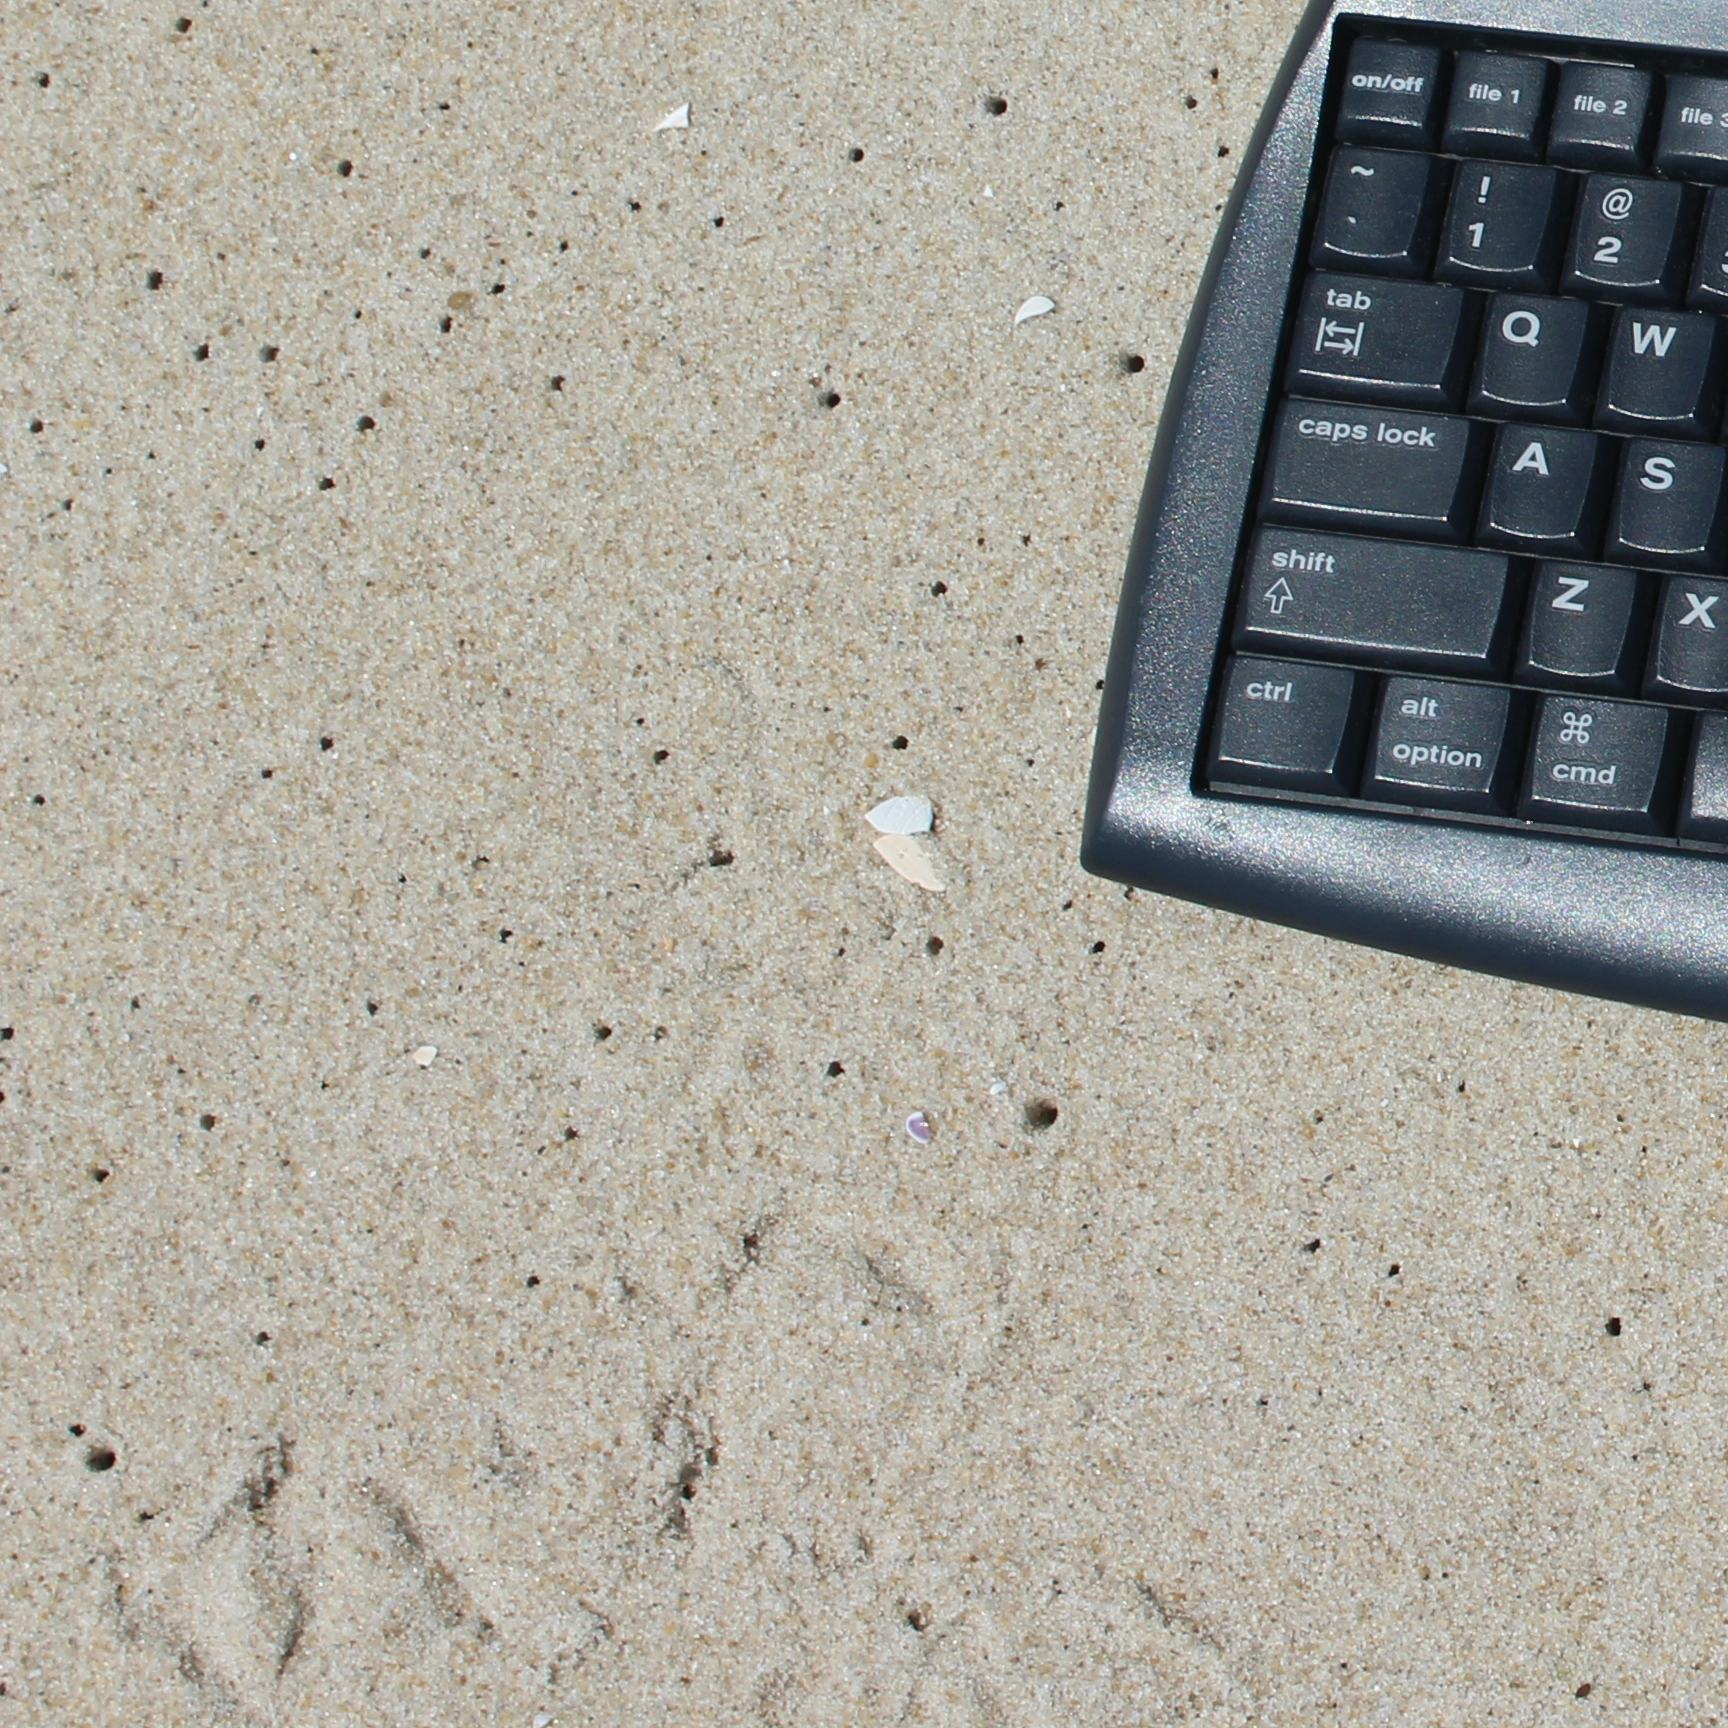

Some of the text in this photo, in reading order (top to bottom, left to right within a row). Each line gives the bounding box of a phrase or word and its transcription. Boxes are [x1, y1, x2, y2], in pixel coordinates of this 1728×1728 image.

[1351, 73, 1424, 93] on/off
[1469, 83, 1520, 104] file 1
[1573, 94, 1628, 115] file 2
[1681, 107, 1714, 126] file
[1468, 222, 1484, 248] 1
[1593, 236, 1622, 264] 2
[1326, 288, 1371, 311] tab
[1502, 310, 1540, 347] Q
[1632, 322, 1677, 357] W
[1298, 419, 1436, 447] caps lock
[1512, 442, 1549, 476] A
[1640, 457, 1676, 490] S
[1271, 549, 1335, 573] shift
[1551, 576, 1589, 612] Z
[1678, 593, 1719, 629] X
[1246, 681, 1293, 702] ctrl
[1401, 696, 1438, 719] alt
[1392, 743, 1482, 768] option
[1552, 764, 1616, 785] cmd
